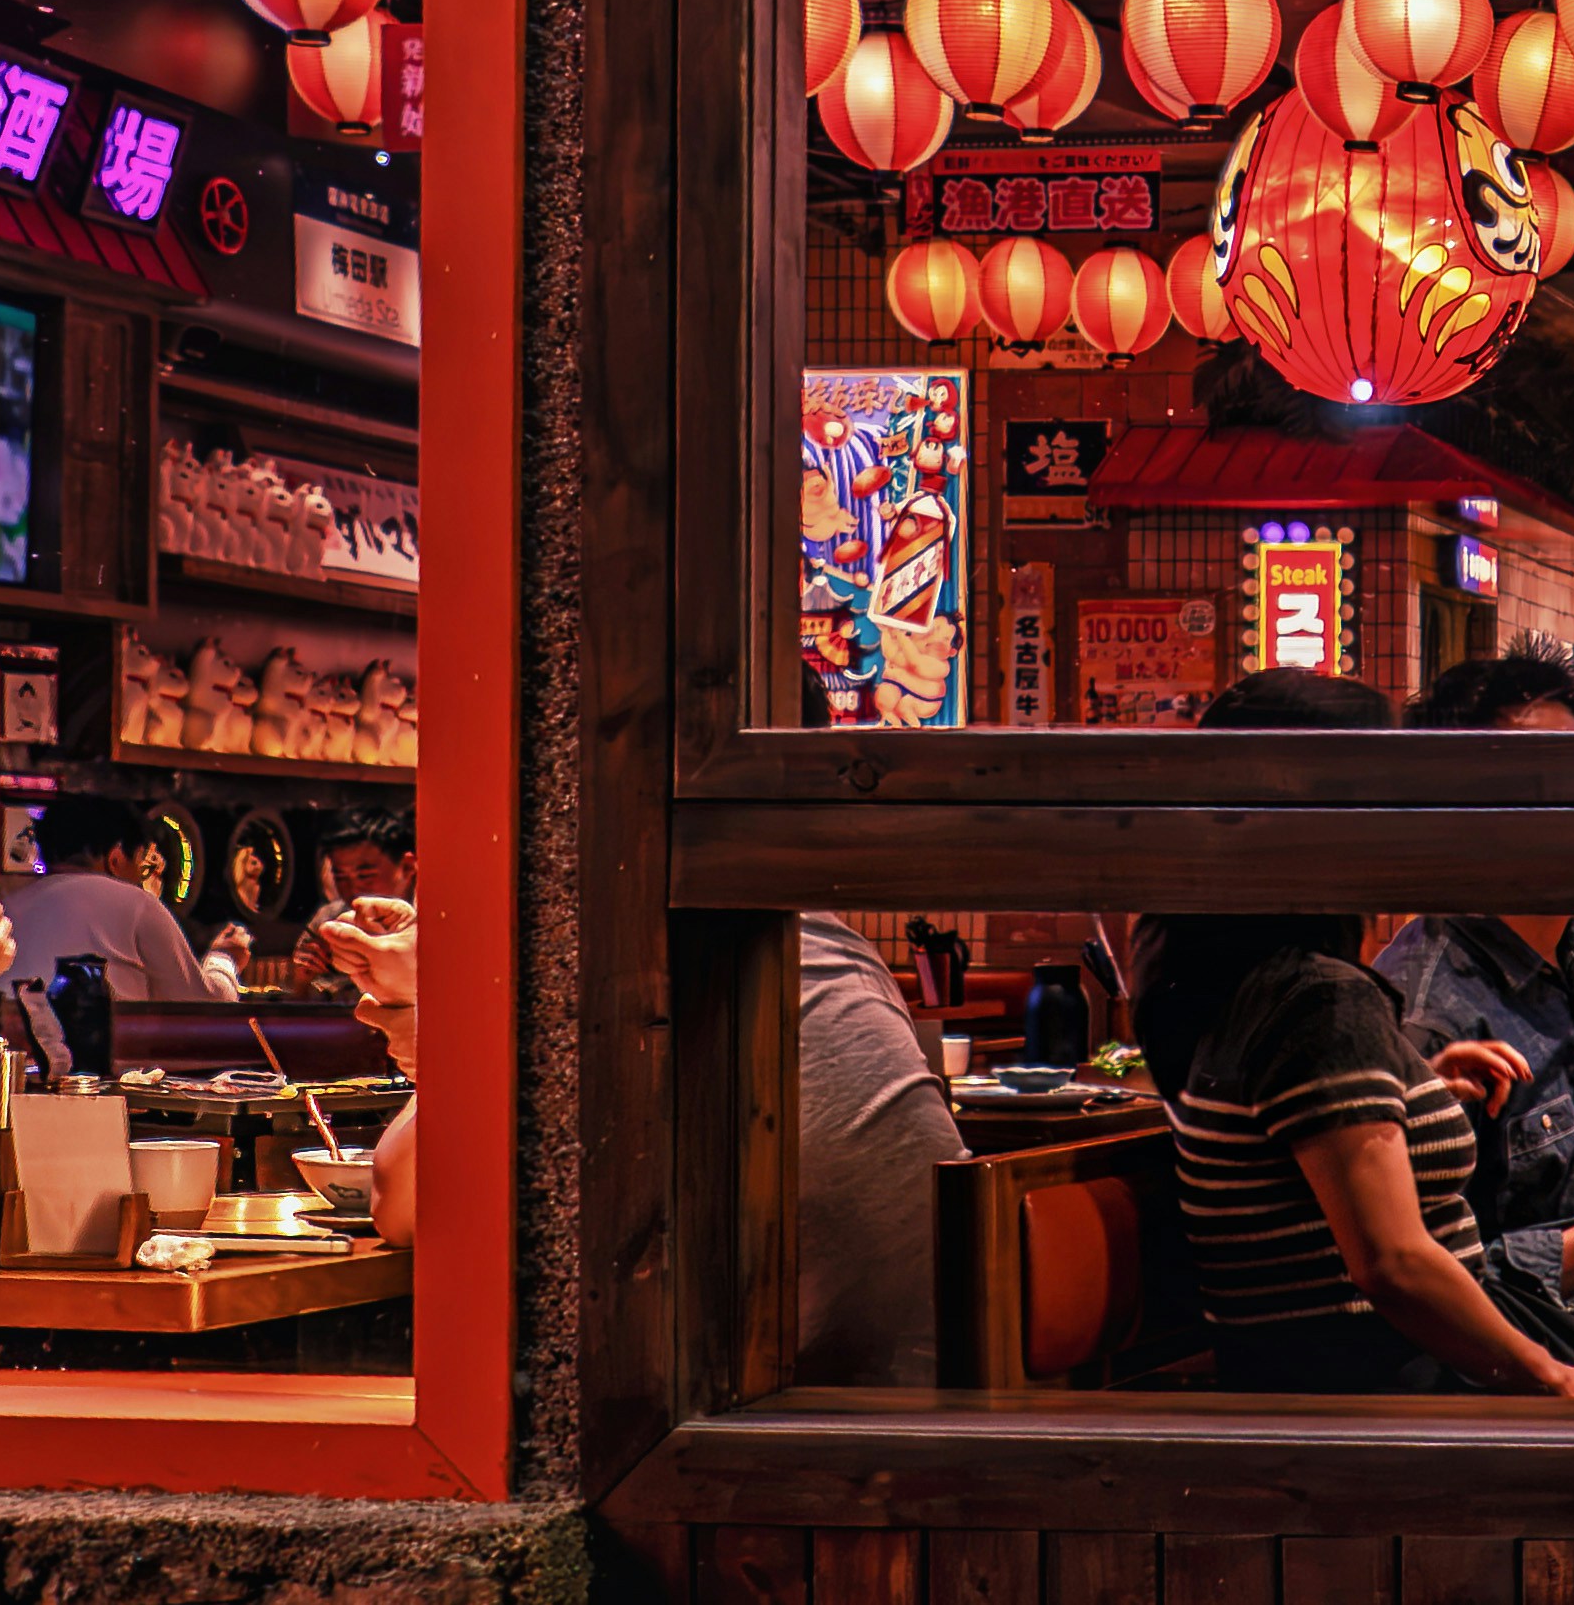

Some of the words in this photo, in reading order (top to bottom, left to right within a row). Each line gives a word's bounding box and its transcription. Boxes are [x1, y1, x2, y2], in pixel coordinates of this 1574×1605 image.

[941, 175, 1153, 231] 漁港直送
[1025, 430, 1088, 486] 塩
[1270, 563, 1328, 586] Steak
[1015, 616, 1040, 727] 名古屋牛
